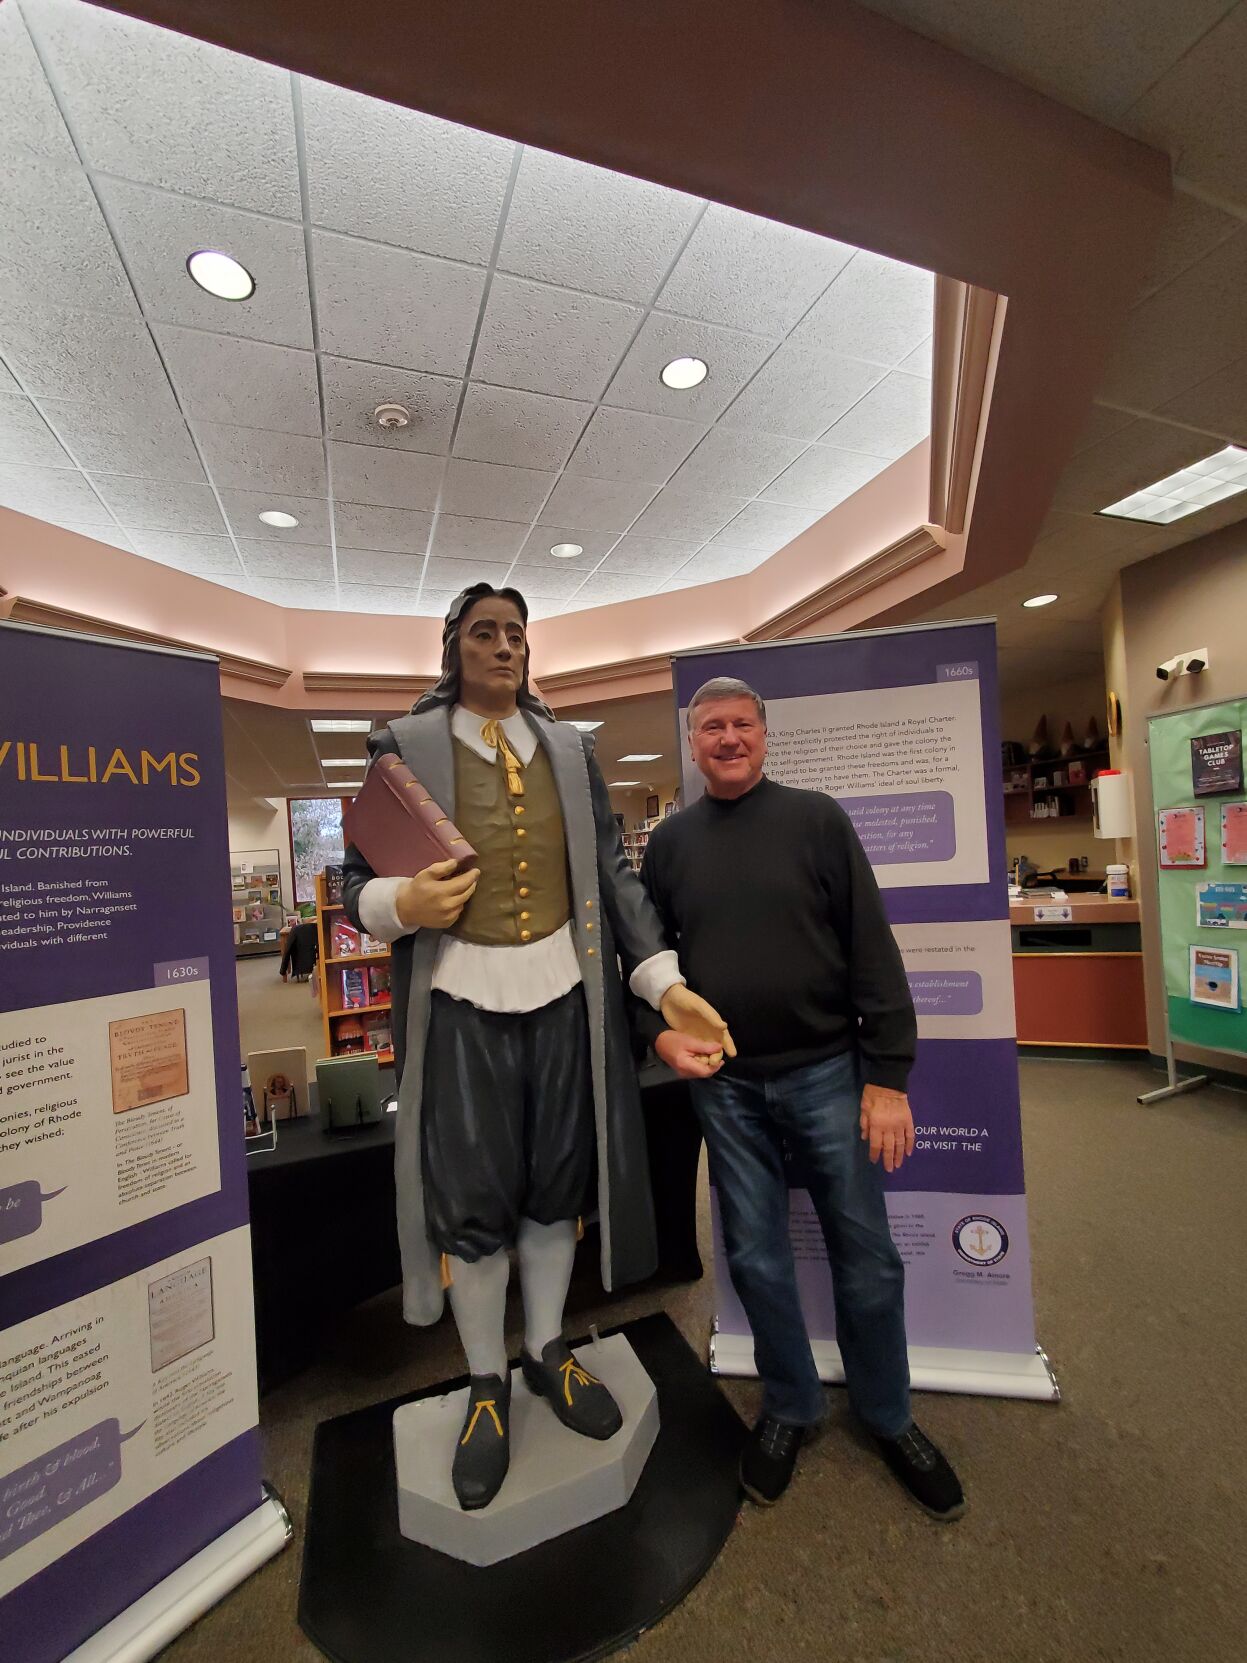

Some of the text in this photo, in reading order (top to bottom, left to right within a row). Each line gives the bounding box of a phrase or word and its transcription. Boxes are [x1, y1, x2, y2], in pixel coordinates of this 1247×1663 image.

[945, 666, 973, 678] 1660s
[795, 728, 821, 736] Charles
[828, 724, 855, 733] granted
[880, 720, 900, 728] Island
[907, 718, 927, 726] Royal
[793, 737, 822, 746] explicitly
[824, 734, 857, 743] protected
[871, 731, 887, 740] right
[889, 729, 896, 737] of
[898, 726, 934, 736] individuals
[781, 748, 792, 756] the
[794, 748, 818, 756] religion
[820, 745, 827, 753] of
[846, 743, 868, 751] choice
[915, 737, 938, 745] colony
[837, 753, 859, 761] Rhode
[924, 746, 947, 754] colony
[1199, 744, 1234, 755] TABLETOP
[1203, 751, 1229, 760] GAMES
[1207, 758, 1226, 767] CLUB
[0, 741, 201, 787] ILLIAMS
[771, 768, 798, 777] England
[819, 764, 846, 774] granted
[868, 760, 899, 769] freedoms
[786, 777, 800, 785] only
[802, 775, 823, 784] colony
[834, 773, 849, 781] have
[886, 769, 912, 777] Charter
[935, 764, 960, 772] formal,
[825, 784, 845, 792] Roger
[896, 778, 904, 786] of
[865, 805, 891, 816] colony
[890, 806, 900, 814] at
[900, 805, 916, 813] any
[917, 802, 936, 811] time
[91, 829, 128, 840] WITH
[131, 828, 195, 840] POWERFUL
[885, 829, 914, 840] for any
[17, 845, 133, 860] CONTRIBUTIONS.
[887, 842, 897, 854] of
[2, 879, 109, 893] Island. Banished from
[92, 891, 133, 900] Williams
[24, 903, 138, 920] to him by Narragansett
[57, 919, 112, 931] Providence
[40, 932, 108, 946] with different
[924, 945, 954, 953] restated
[167, 965, 199, 979] 1630s
[914, 979, 969, 989] establishment
[35, 1036, 47, 1044] to
[2, 1045, 64, 1067] jurist in the
[5, 1057, 75, 1079] see the value
[6, 1072, 73, 1095] government.
[34, 1098, 78, 1115] religious
[34, 1117, 46, 1129] of
[48, 1109, 82, 1125] Rhode
[24, 1127, 65, 1146] wished;
[939, 1126, 979, 1137] WORLD
[980, 1128, 989, 1137] A
[915, 1140, 982, 1152] OR VISIT THE
[51, 1322, 93, 1345] Arriving
[95, 1316, 104, 1325] in
[38, 1337, 88, 1364] languages
[48, 1342, 101, 1374] This eased
[4, 1354, 109, 1411] friendships between
[15, 1371, 102, 1420] and Wampanoag
[13, 1380, 110, 1435] after his expulsion
